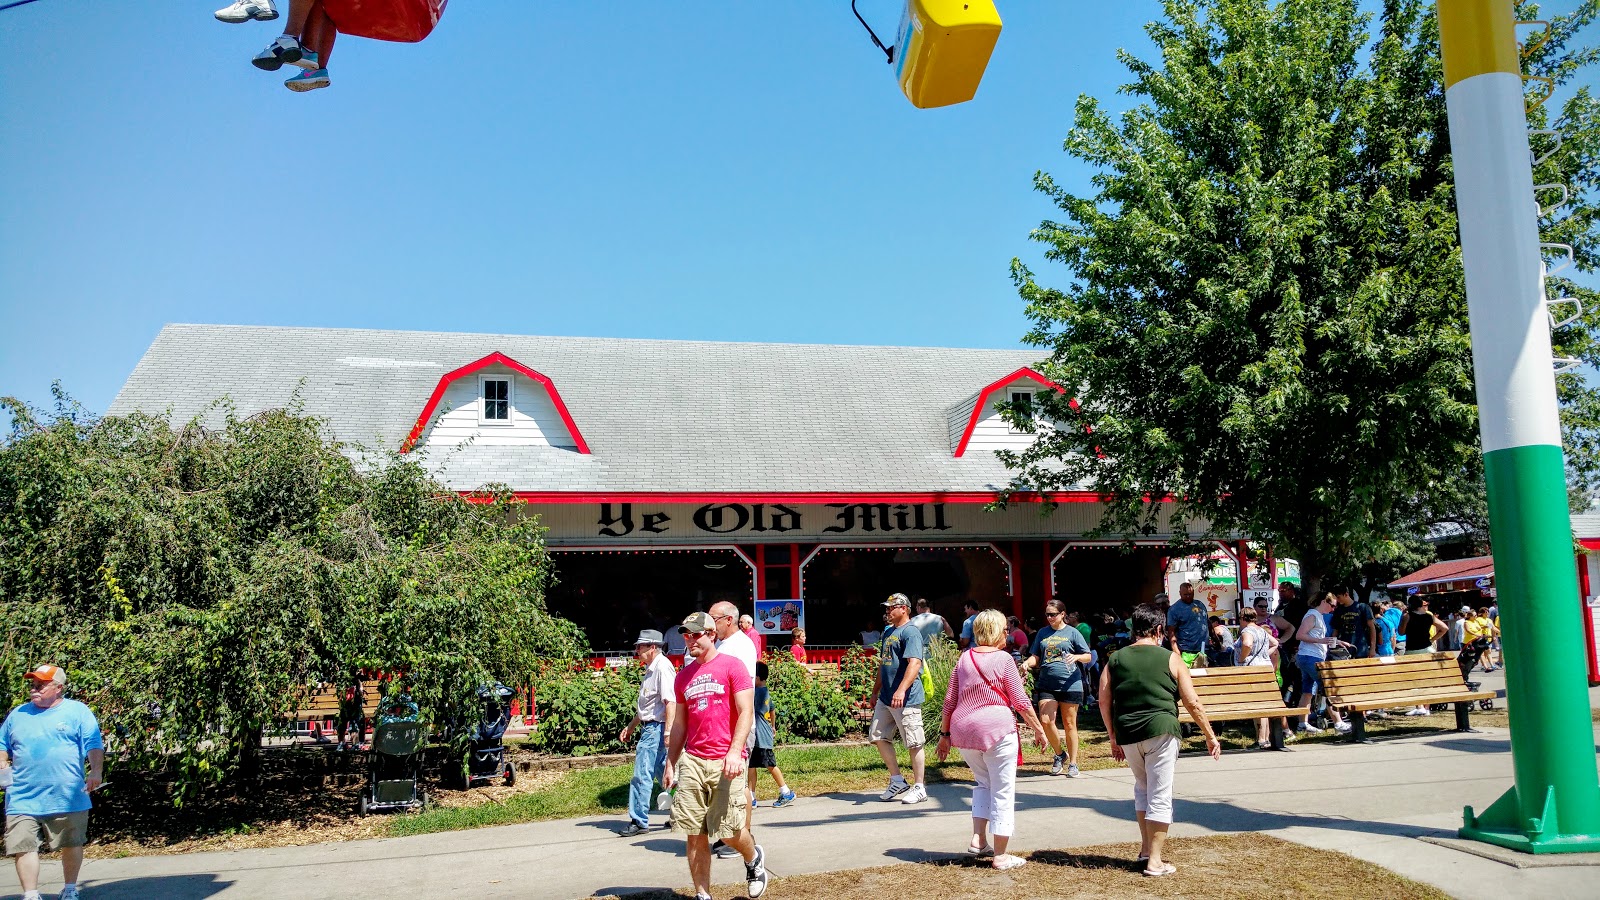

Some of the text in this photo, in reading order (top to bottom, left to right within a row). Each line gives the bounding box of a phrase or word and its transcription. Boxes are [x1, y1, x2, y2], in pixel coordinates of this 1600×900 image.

[598, 503, 952, 537] Ye Old Mill
[1198, 584, 1228, 593] Campbell's
